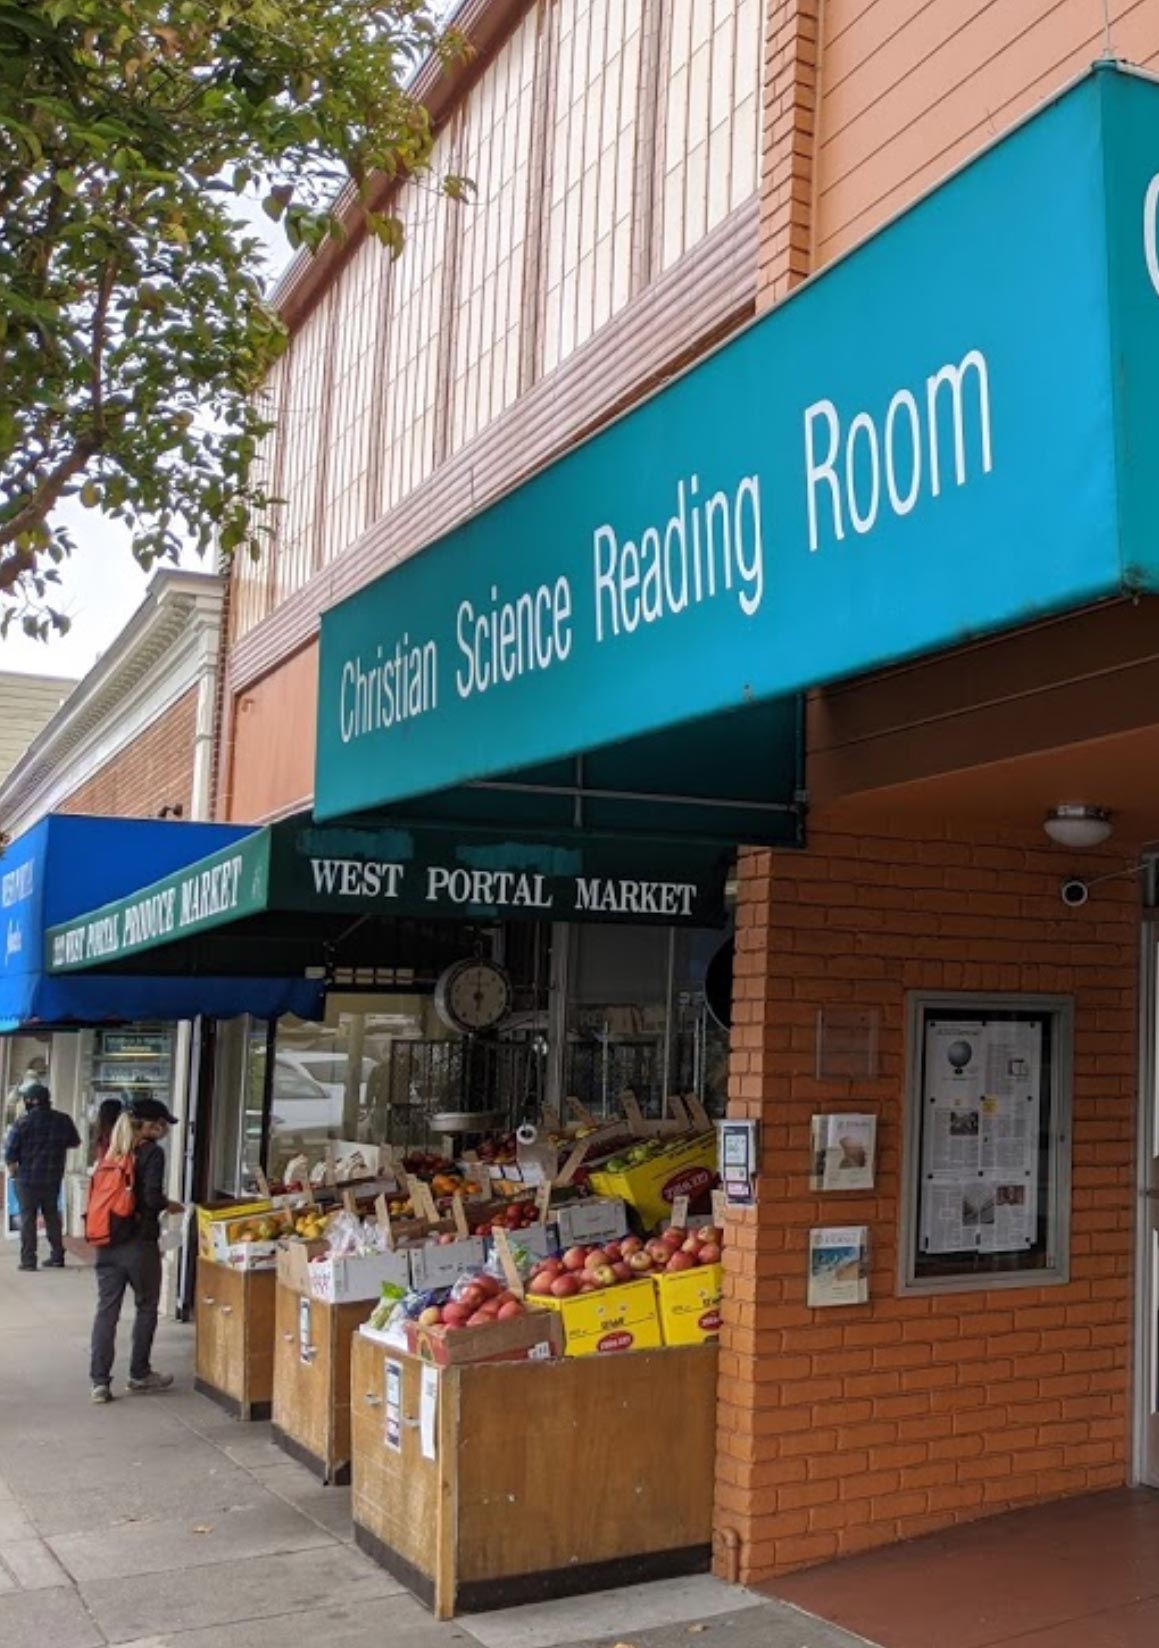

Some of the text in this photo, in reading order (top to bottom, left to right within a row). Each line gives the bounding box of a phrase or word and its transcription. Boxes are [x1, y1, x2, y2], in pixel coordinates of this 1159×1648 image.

[340, 350, 992, 743] Christian Science Reading Room
[122, 887, 177, 948] PRODUCE
[179, 855, 243, 927] MARKET
[311, 859, 697, 915] WEST PORTAL MARKET
